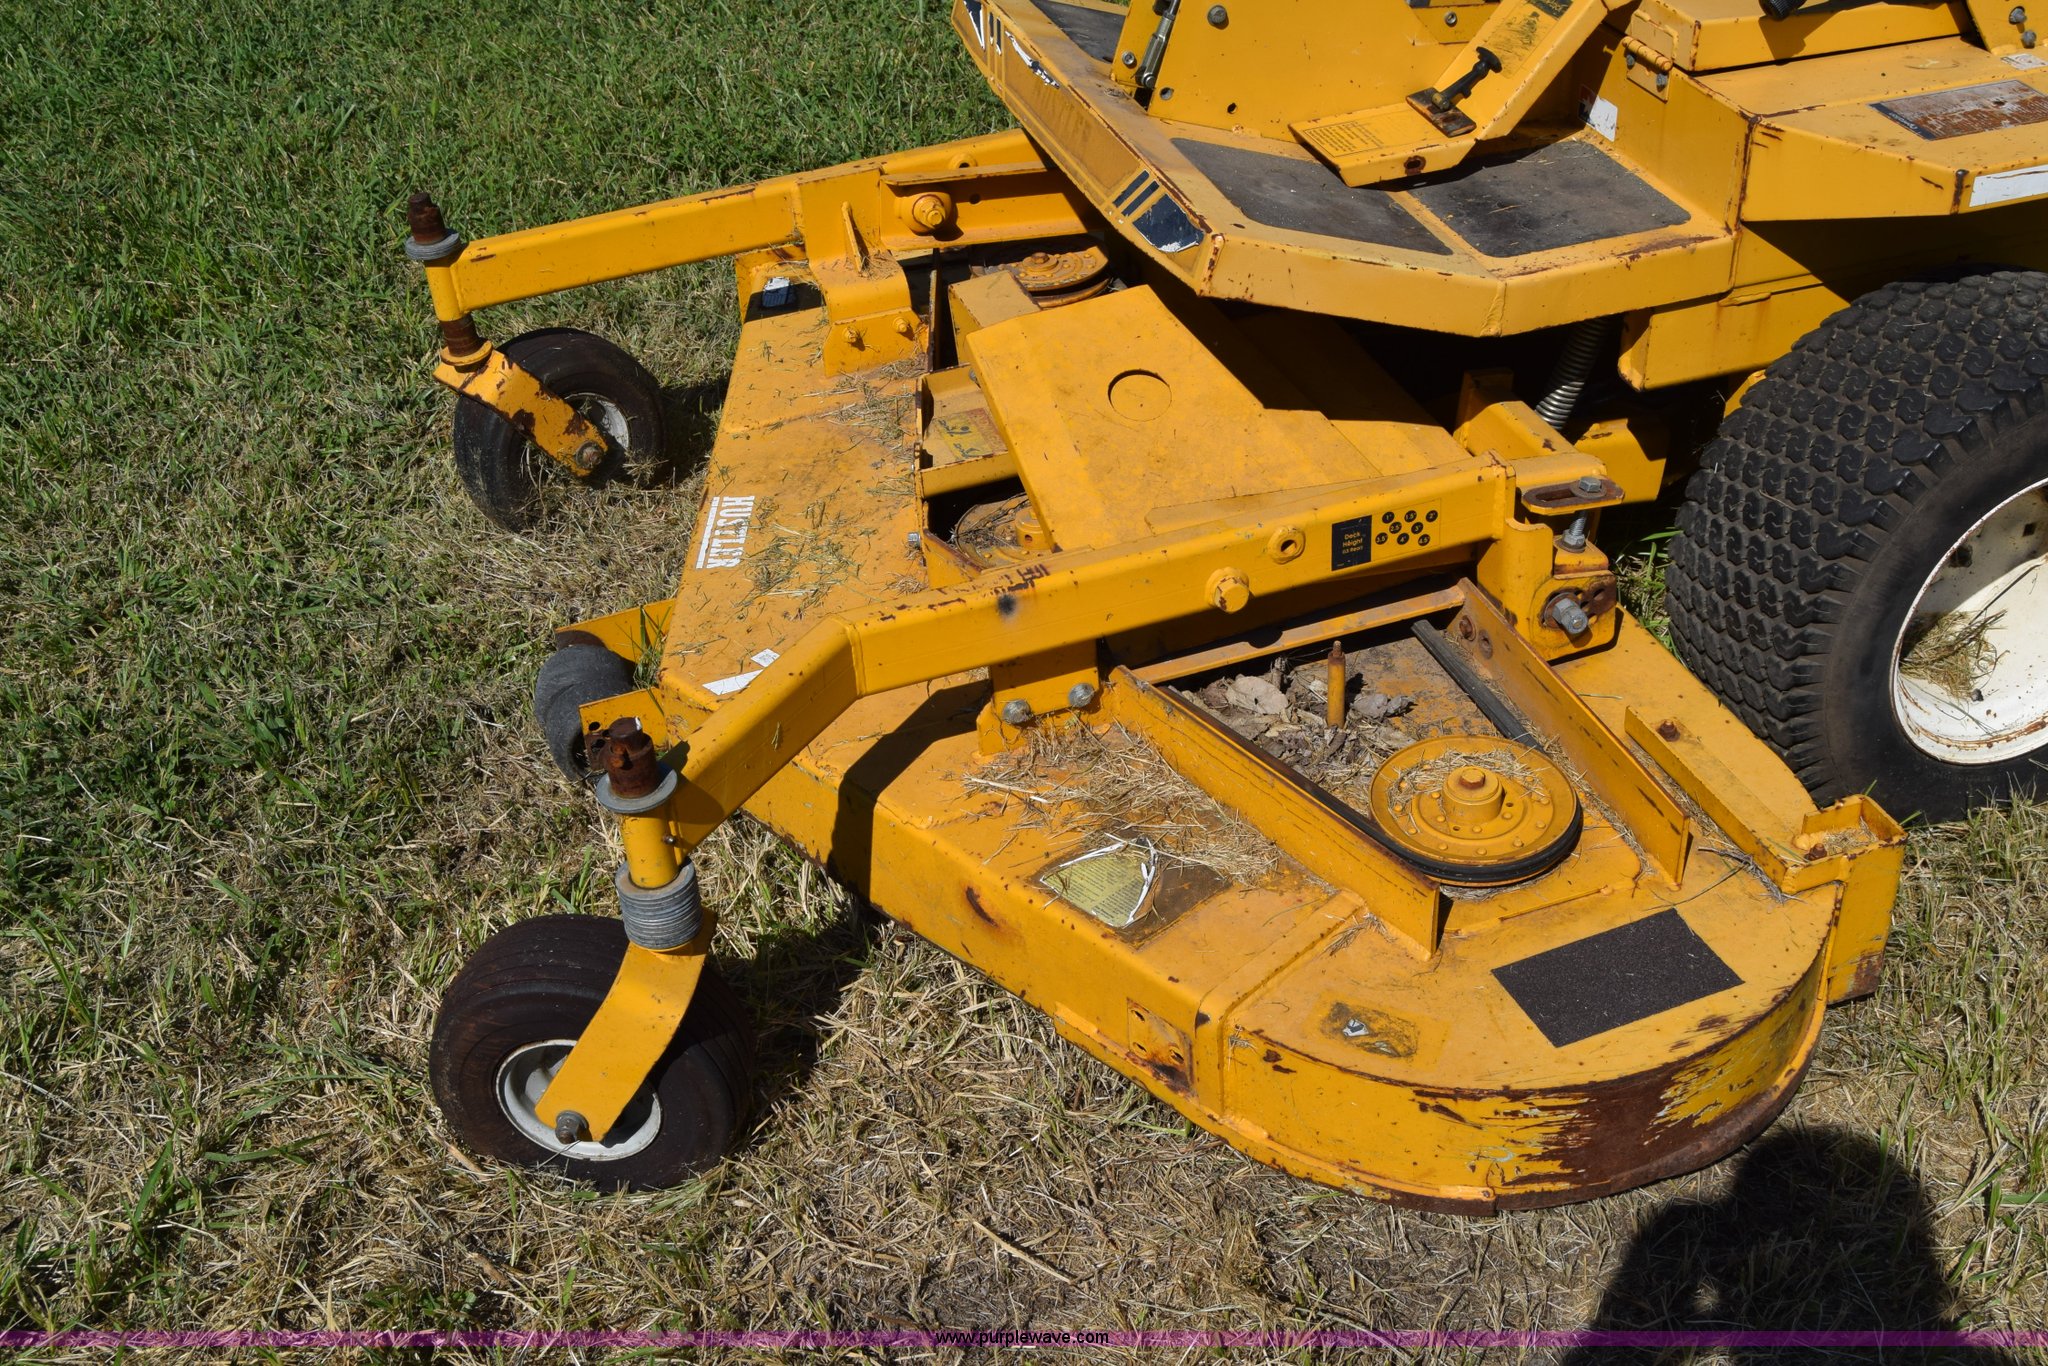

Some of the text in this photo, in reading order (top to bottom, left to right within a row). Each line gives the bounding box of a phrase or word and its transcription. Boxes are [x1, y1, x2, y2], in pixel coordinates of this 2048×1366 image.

[706, 496, 755, 569] HUSTLER
[1344, 532, 1360, 540] Deck
[1342, 538, 1363, 548] Height
